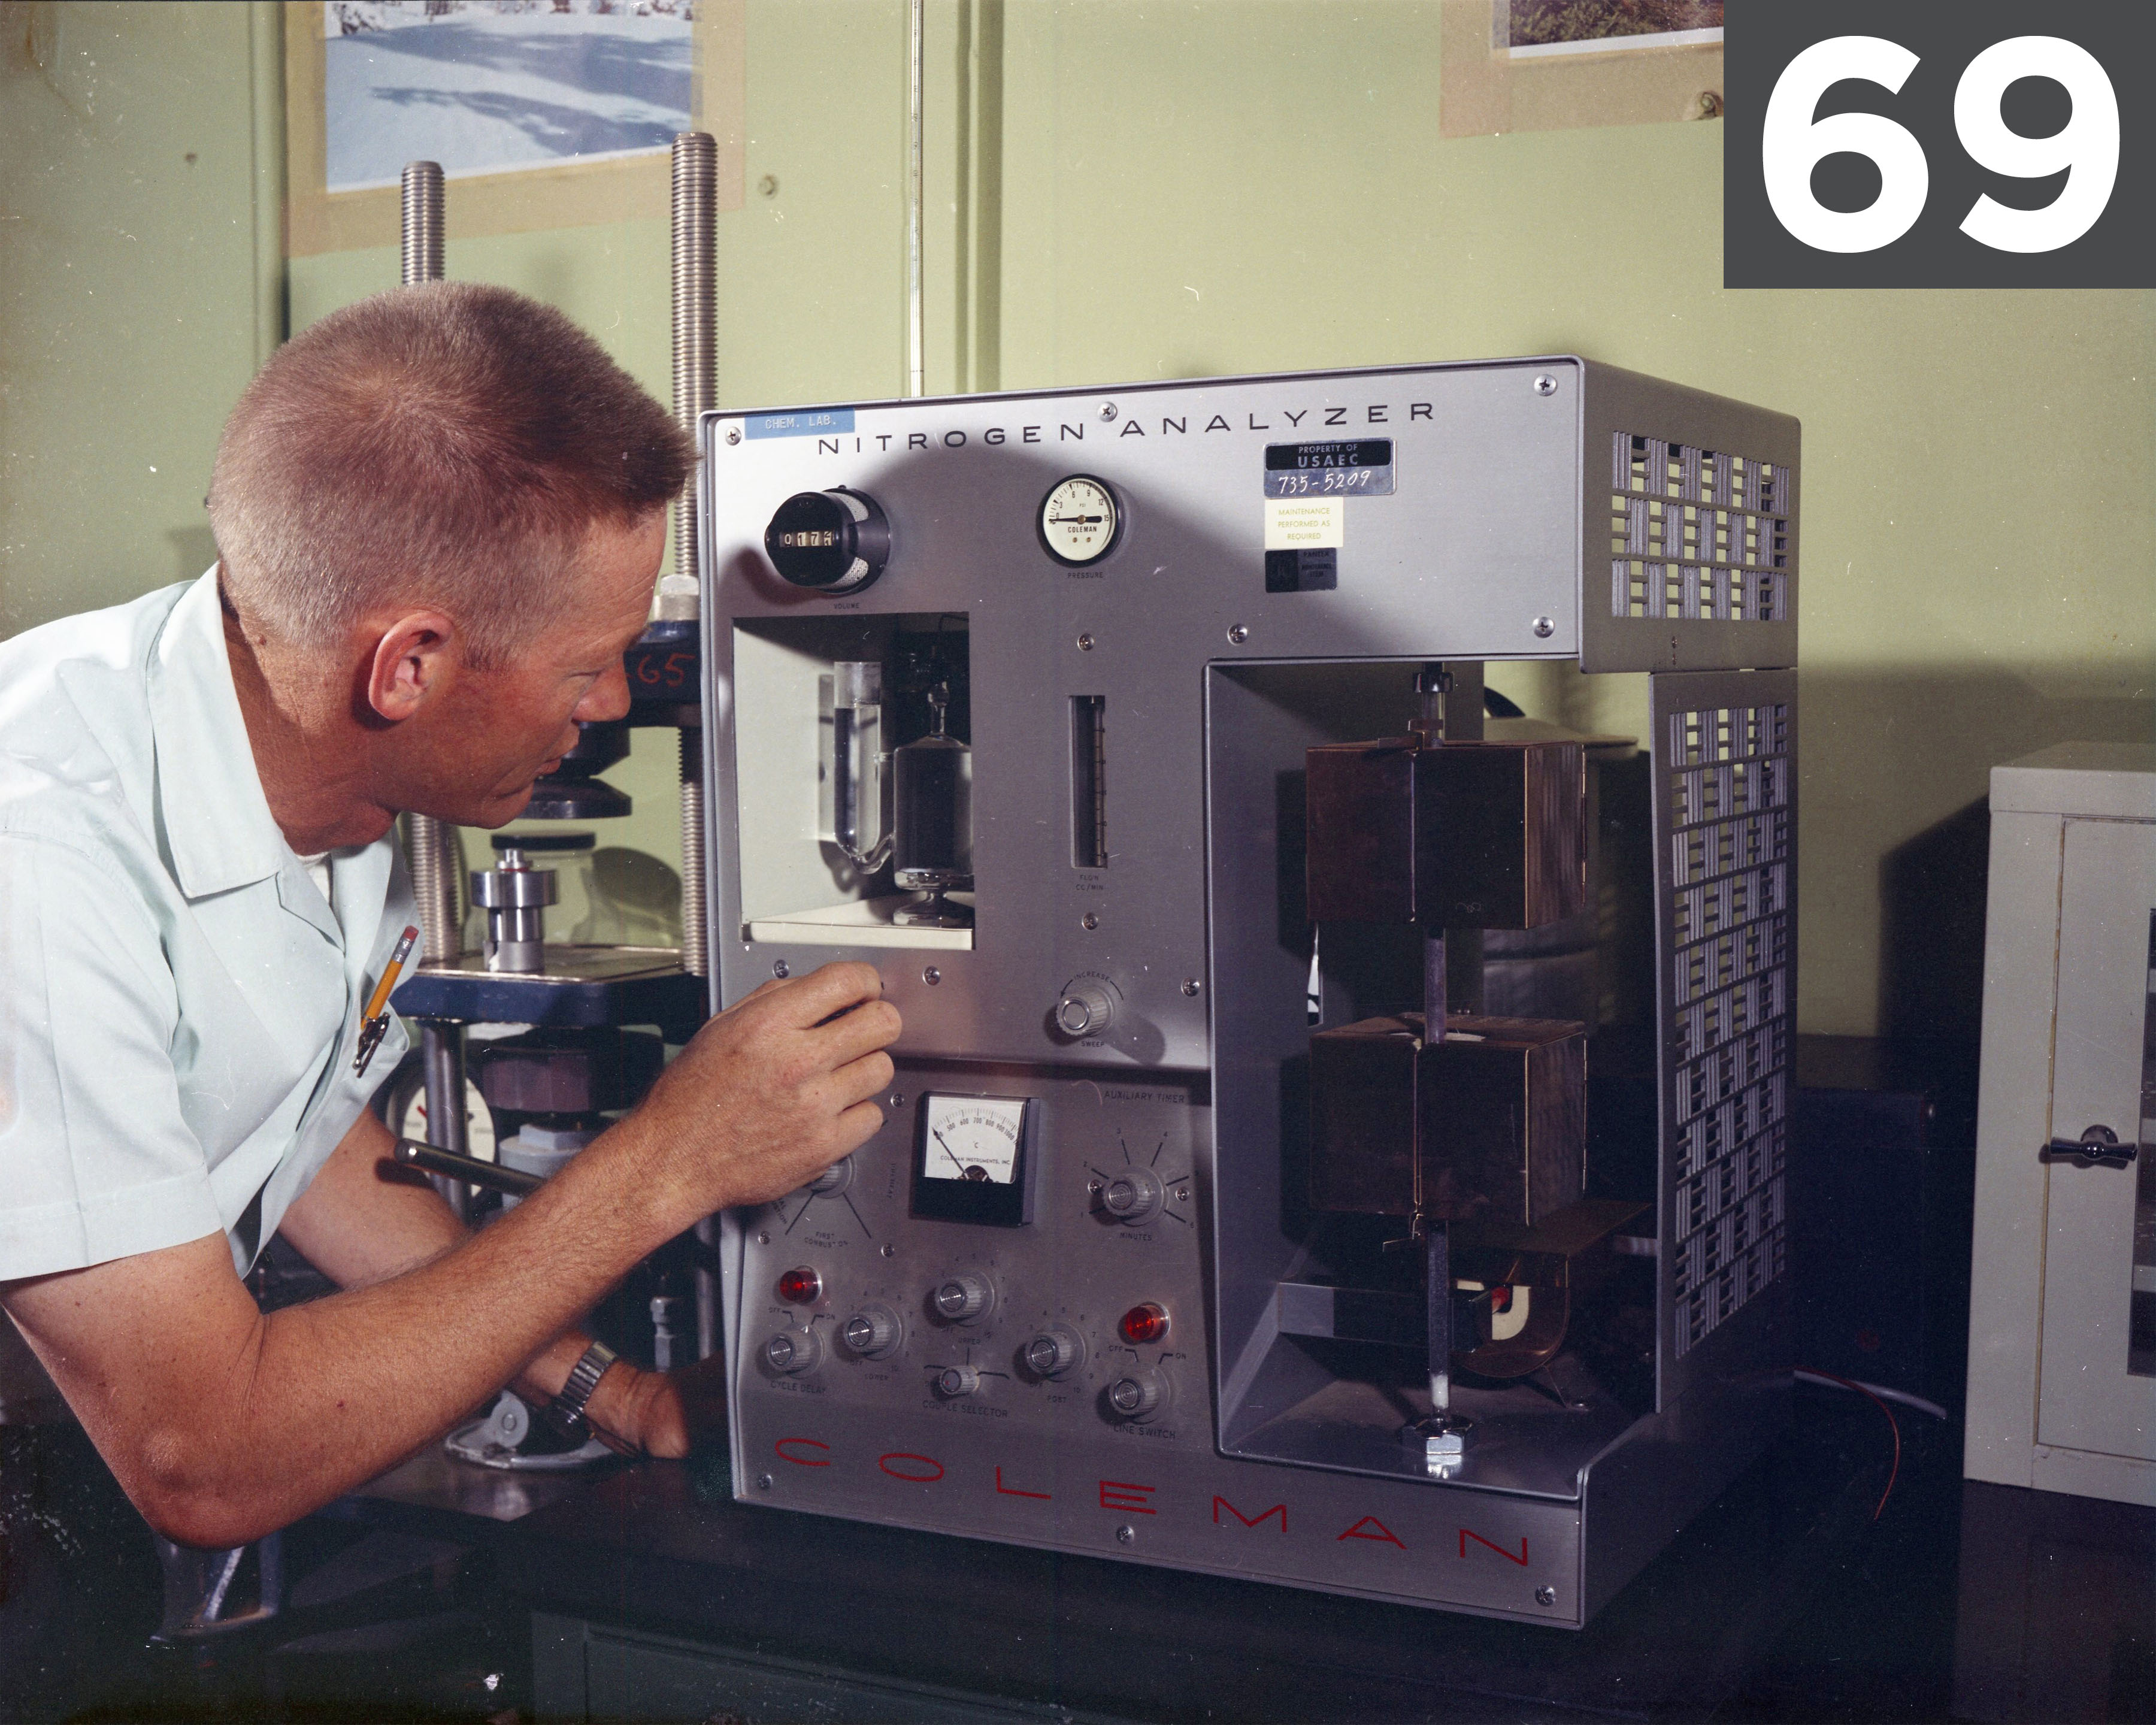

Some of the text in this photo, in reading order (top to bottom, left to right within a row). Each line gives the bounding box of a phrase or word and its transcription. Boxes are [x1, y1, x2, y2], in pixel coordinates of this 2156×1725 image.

[765, 415, 837, 429] CHEM. LAB.
[818, 402, 1434, 455] NITROGEN ANALYZER
[1298, 443, 1358, 454] PROPERTY OF
[1298, 453, 1359, 468] USAEC
[1279, 470, 1371, 494] 735-5209
[1278, 507, 1331, 516] MAINTENANCE
[1277, 520, 1319, 528] PERFORMED
[1286, 532, 1322, 541] REQUIRED
[637, 652, 695, 687] 65
[1076, 883, 1104, 892] CC/MIN
[1073, 970, 1111, 982] INCREASE
[1104, 1090, 1186, 1103] AUXILIARY TIMER
[946, 1122, 956, 1131] 500
[985, 1119, 995, 1127] 800
[996, 1123, 1005, 1133] 900
[1004, 1128, 1015, 1140] 1000
[1119, 1232, 1153, 1242] MINUTES
[770, 1380, 826, 1394] CYCLE DELAY
[922, 1399, 1009, 1418] COUPLE SELECTOR
[1113, 1424, 1176, 1440] LINE SWITCH
[774, 1438, 1528, 1567] COLEMAN
